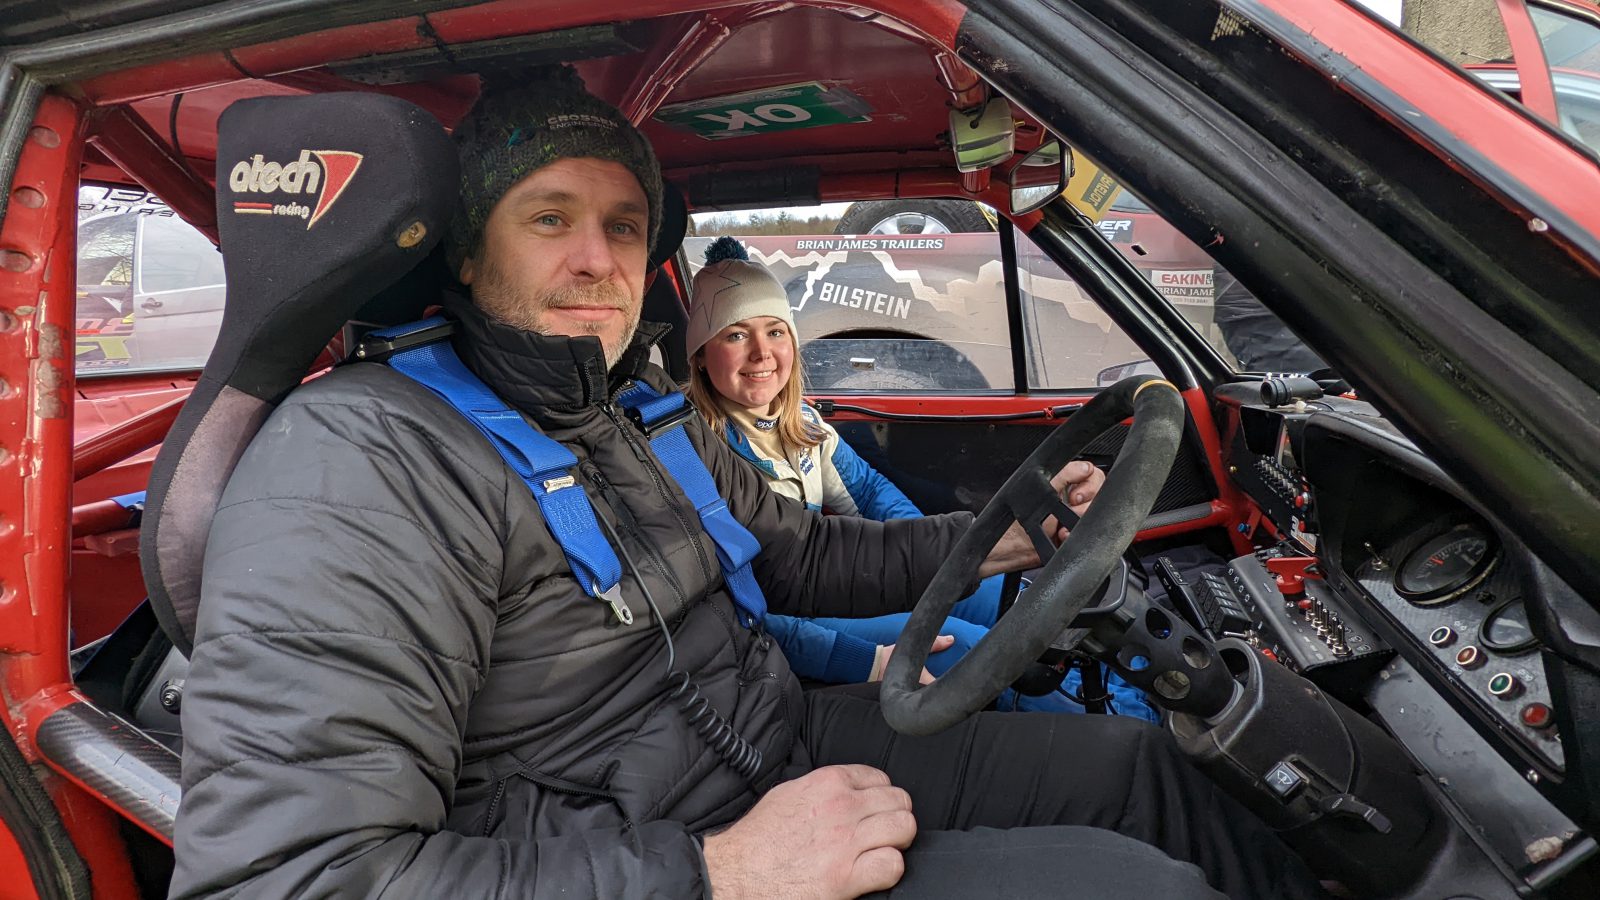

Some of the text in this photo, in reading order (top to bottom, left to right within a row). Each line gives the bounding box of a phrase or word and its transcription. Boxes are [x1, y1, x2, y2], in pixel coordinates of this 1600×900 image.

[547, 114, 619, 128] CROSSEN
[696, 104, 811, 130] OK
[229, 150, 321, 194] atech
[273, 202, 310, 219] racing
[796, 238, 944, 250] BRIAN JAMES TRAILERS
[1161, 273, 1206, 285] EAKIN
[1157, 287, 1215, 297] BRIAN JAME
[819, 282, 911, 319] BILSTEIN
